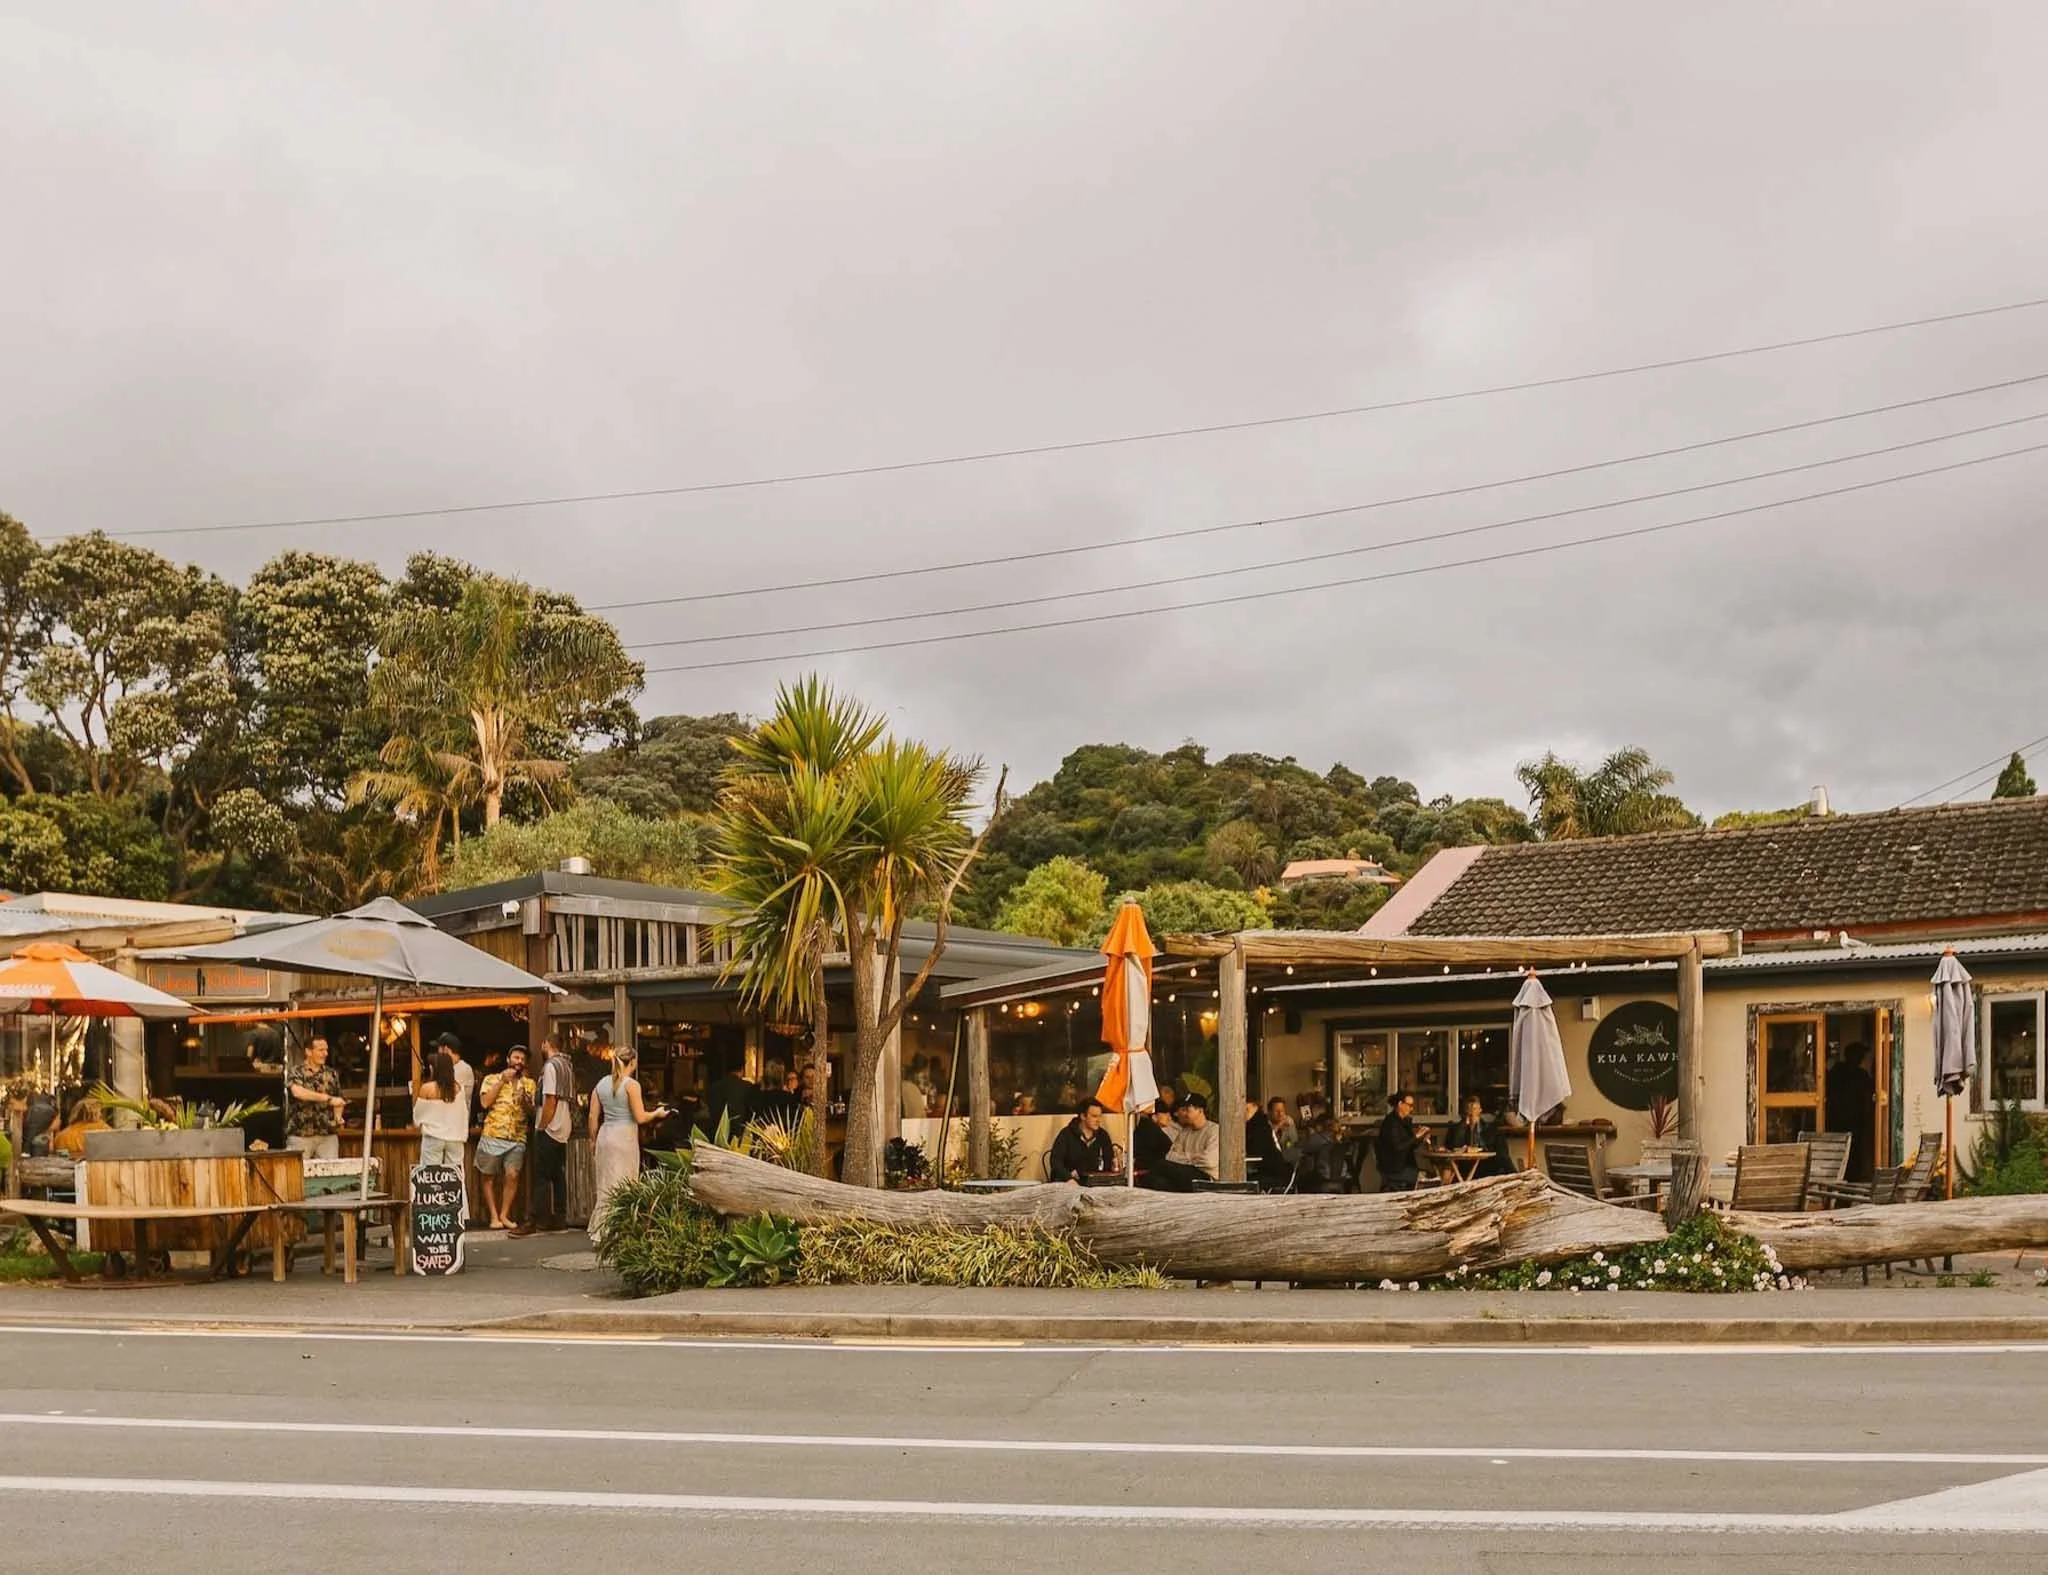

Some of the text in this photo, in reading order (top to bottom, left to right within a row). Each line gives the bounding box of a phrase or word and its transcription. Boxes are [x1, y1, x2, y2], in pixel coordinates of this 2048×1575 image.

[1597, 1052, 1680, 1063] KUA KAWH
[415, 1170, 457, 1183] WELCOME
[431, 1184, 442, 1192] TO
[416, 1189, 461, 1205] LUKE'S!
[418, 1213, 451, 1231] PLEASE
[417, 1232, 455, 1244] WAIT
[427, 1244, 449, 1254] TO BE
